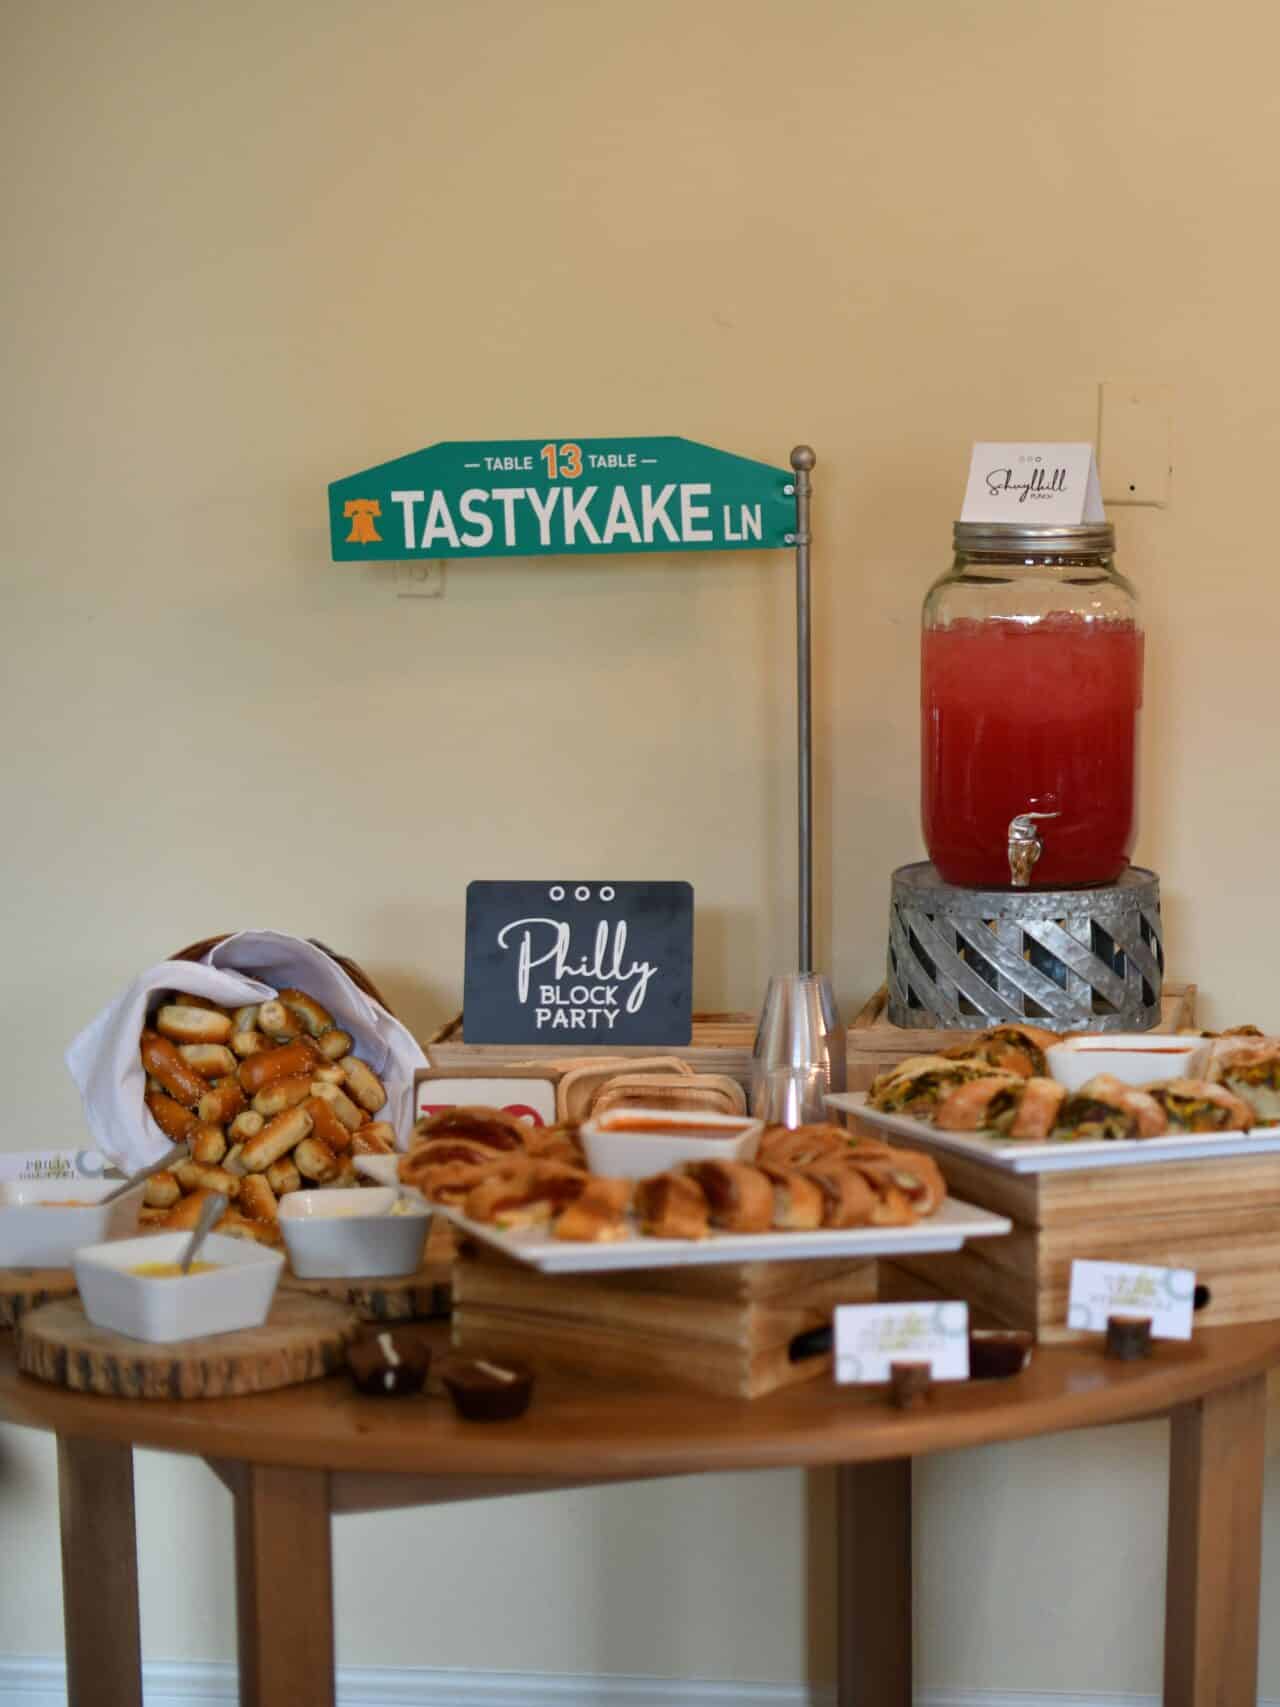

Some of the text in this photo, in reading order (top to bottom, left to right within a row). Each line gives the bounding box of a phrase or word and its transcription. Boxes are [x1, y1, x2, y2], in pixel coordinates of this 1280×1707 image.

[484, 443, 637, 479] TABLE 13 TABLE
[391, 483, 763, 549] TASTYKAKE LN
[497, 917, 658, 1013] Philly
[539, 984, 619, 1005] BLOCK
[535, 1008, 620, 1029] PARTY
